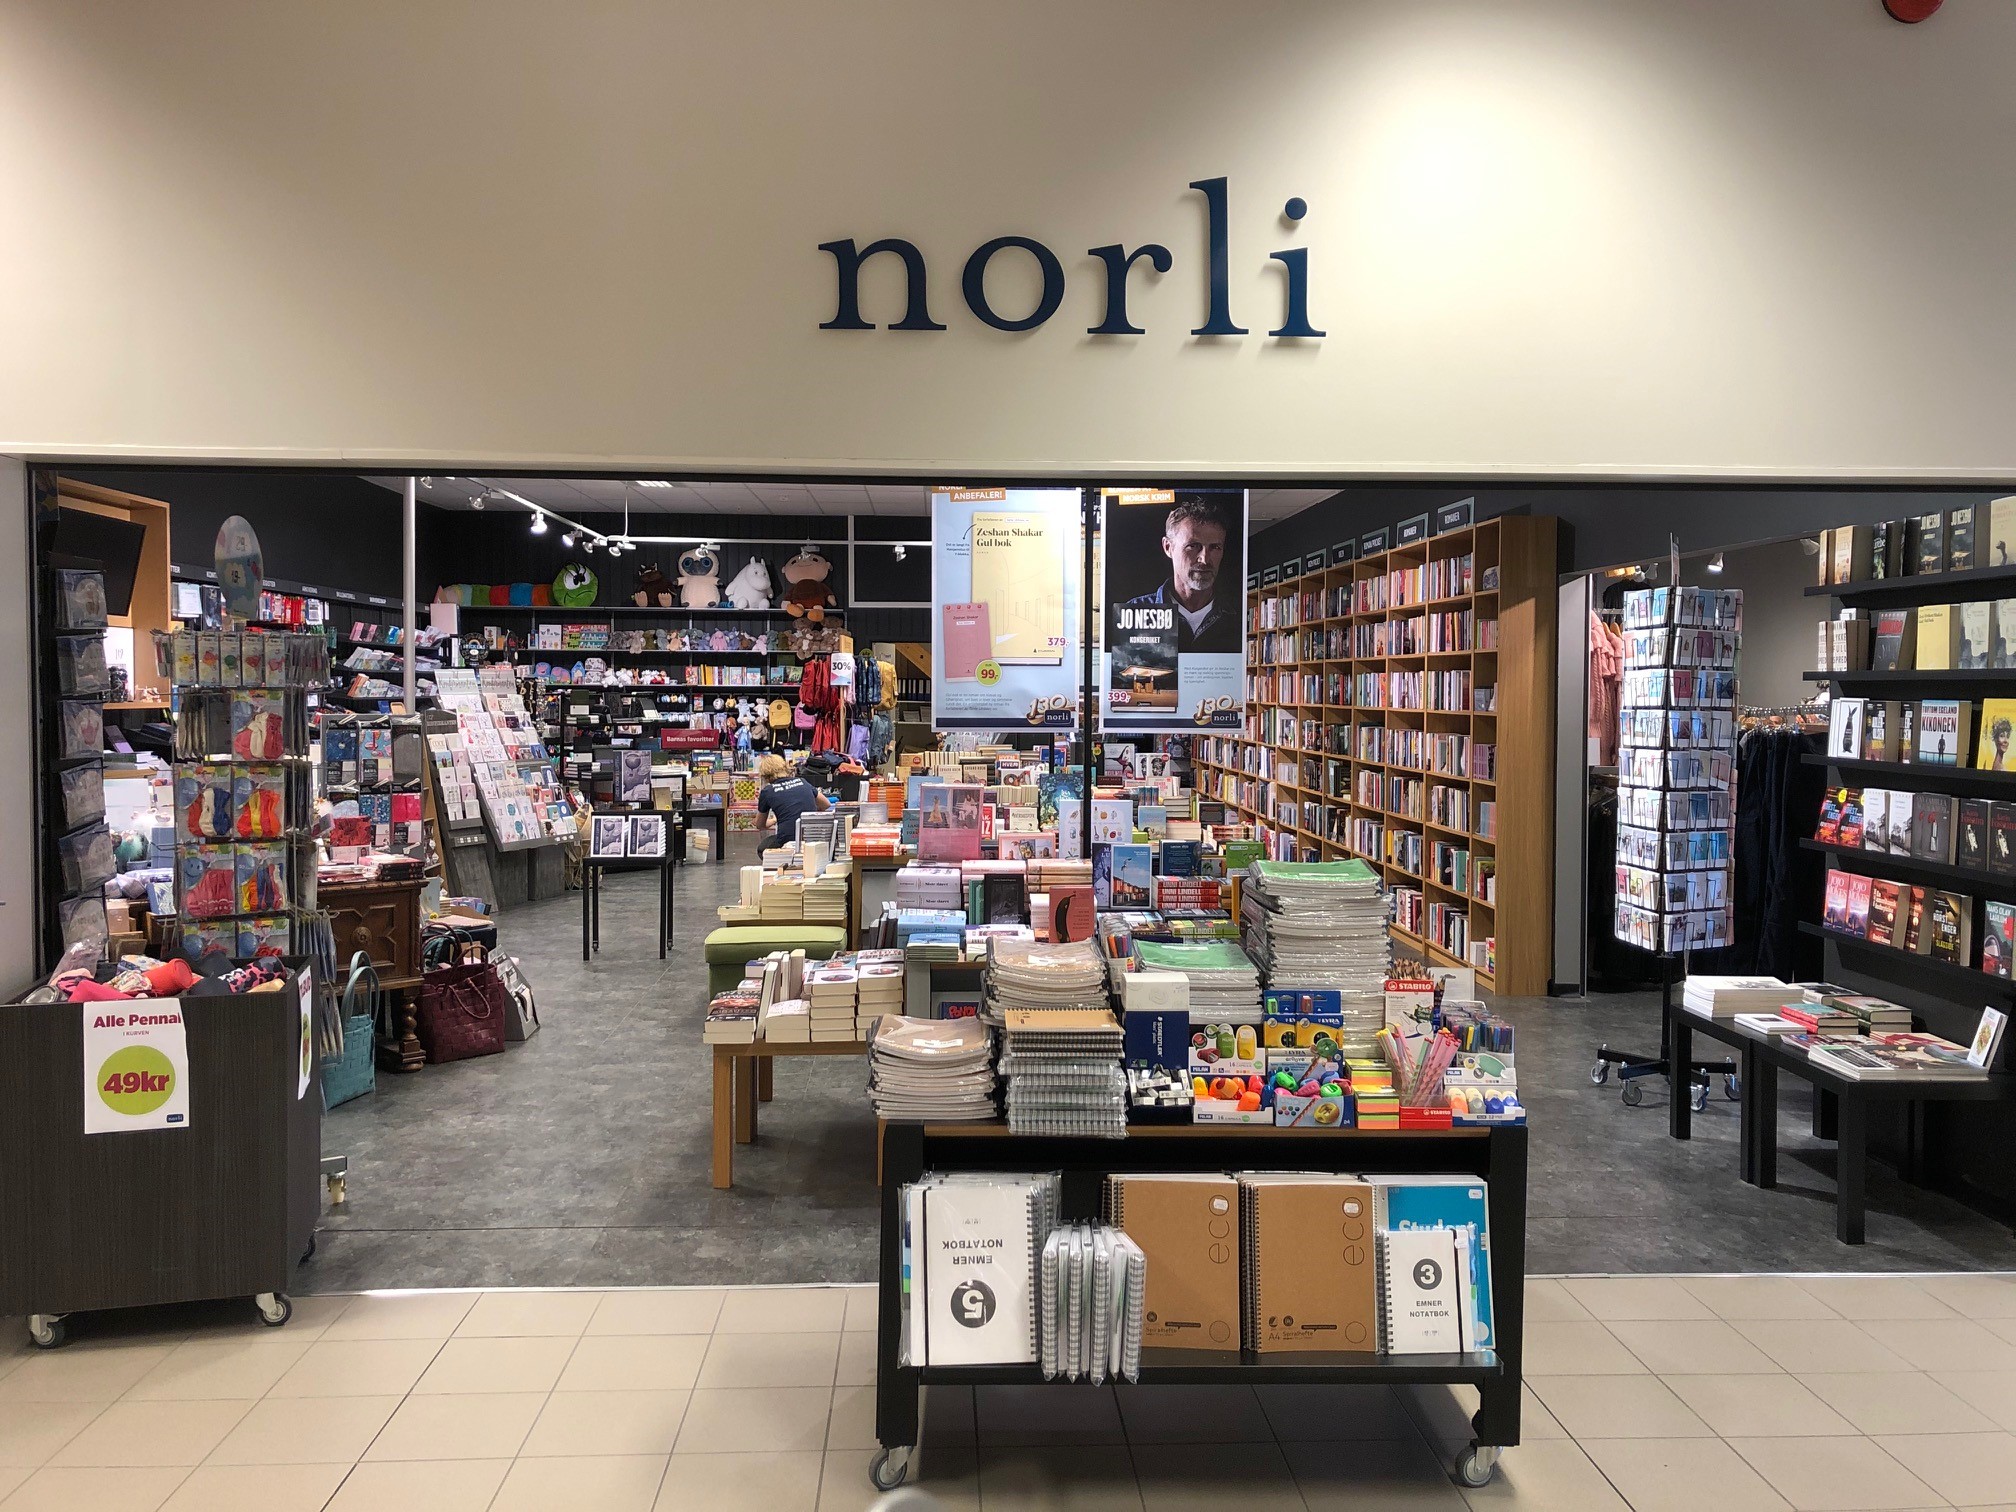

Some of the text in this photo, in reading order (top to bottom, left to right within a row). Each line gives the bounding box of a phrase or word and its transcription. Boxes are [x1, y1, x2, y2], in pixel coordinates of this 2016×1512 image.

[818, 177, 1326, 337] norli
[954, 491, 1003, 500] ANBEFALER!
[976, 528, 1044, 537] Zeshan Shakar
[976, 538, 1012, 548] Gul bok
[1117, 608, 1173, 630] JO NESBØ
[1130, 636, 1161, 644] KONGERIKET
[832, 662, 852, 671] 30%
[1047, 712, 1069, 721] norli
[1214, 713, 1236, 722] norli
[1942, 924, 1957, 935] ENGER
[1398, 983, 1431, 991] STABILO
[94, 1015, 125, 1028] Alle
[104, 1070, 170, 1094] 49kr
[942, 1238, 1003, 1249] NOTATBOK
[952, 1255, 993, 1265] EMNER
[1420, 1264, 1436, 1285] 3
[962, 1290, 984, 1319] 5
[1410, 1310, 1450, 1318] NOTATBOK
[1268, 1332, 1280, 1341] A4
